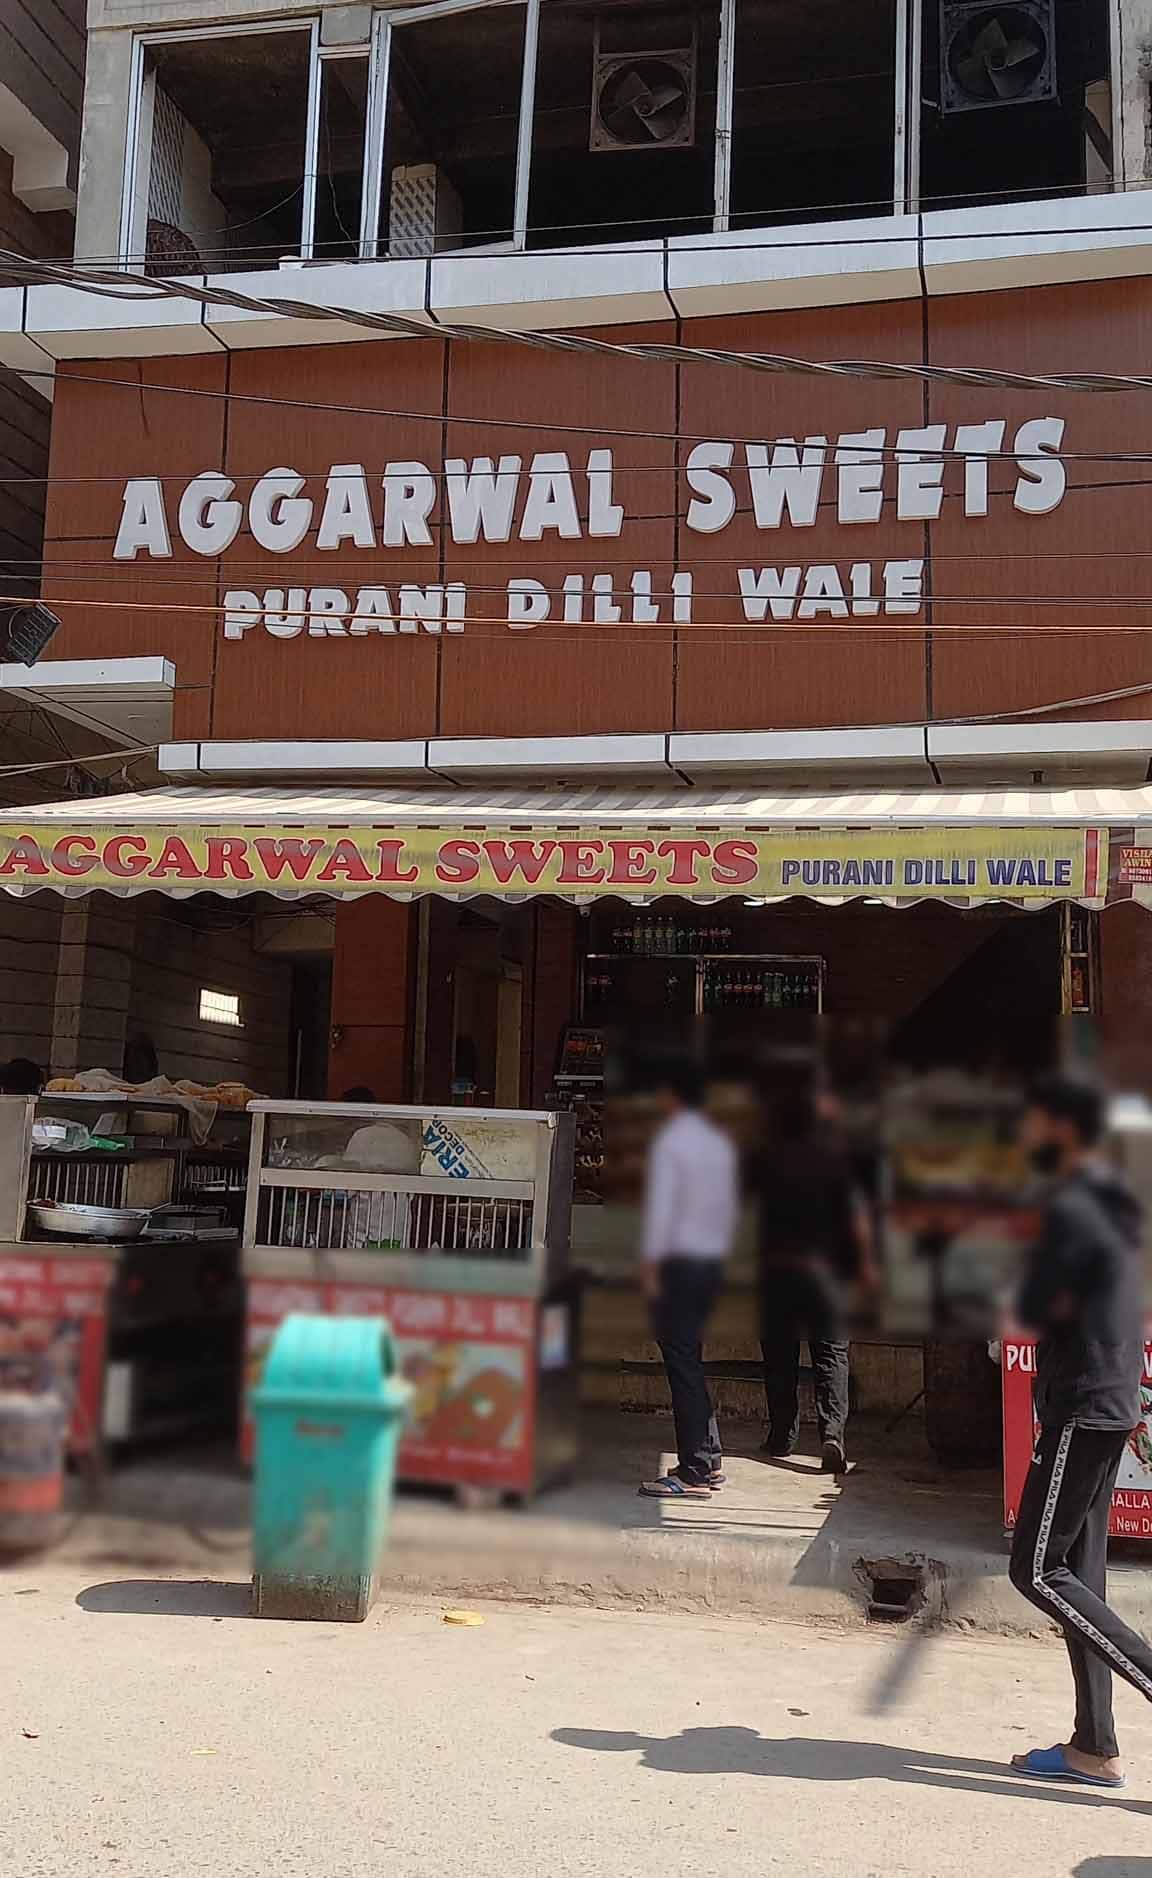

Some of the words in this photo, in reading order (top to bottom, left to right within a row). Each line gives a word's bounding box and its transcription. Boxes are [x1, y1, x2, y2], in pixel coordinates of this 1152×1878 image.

[112, 449, 624, 559] AGGARWAL
[686, 416, 1067, 534] SWEETS
[222, 583, 467, 640] PURANI
[506, 570, 693, 630] DILLI
[737, 560, 924, 622] WALE
[0, 834, 419, 882] AGGARWAL
[435, 839, 759, 885] SWEETS
[781, 858, 894, 886] PURANI
[903, 858, 976, 886] DILLI
[986, 859, 1073, 887] WALE
[1116, 1515, 1139, 1532] New
